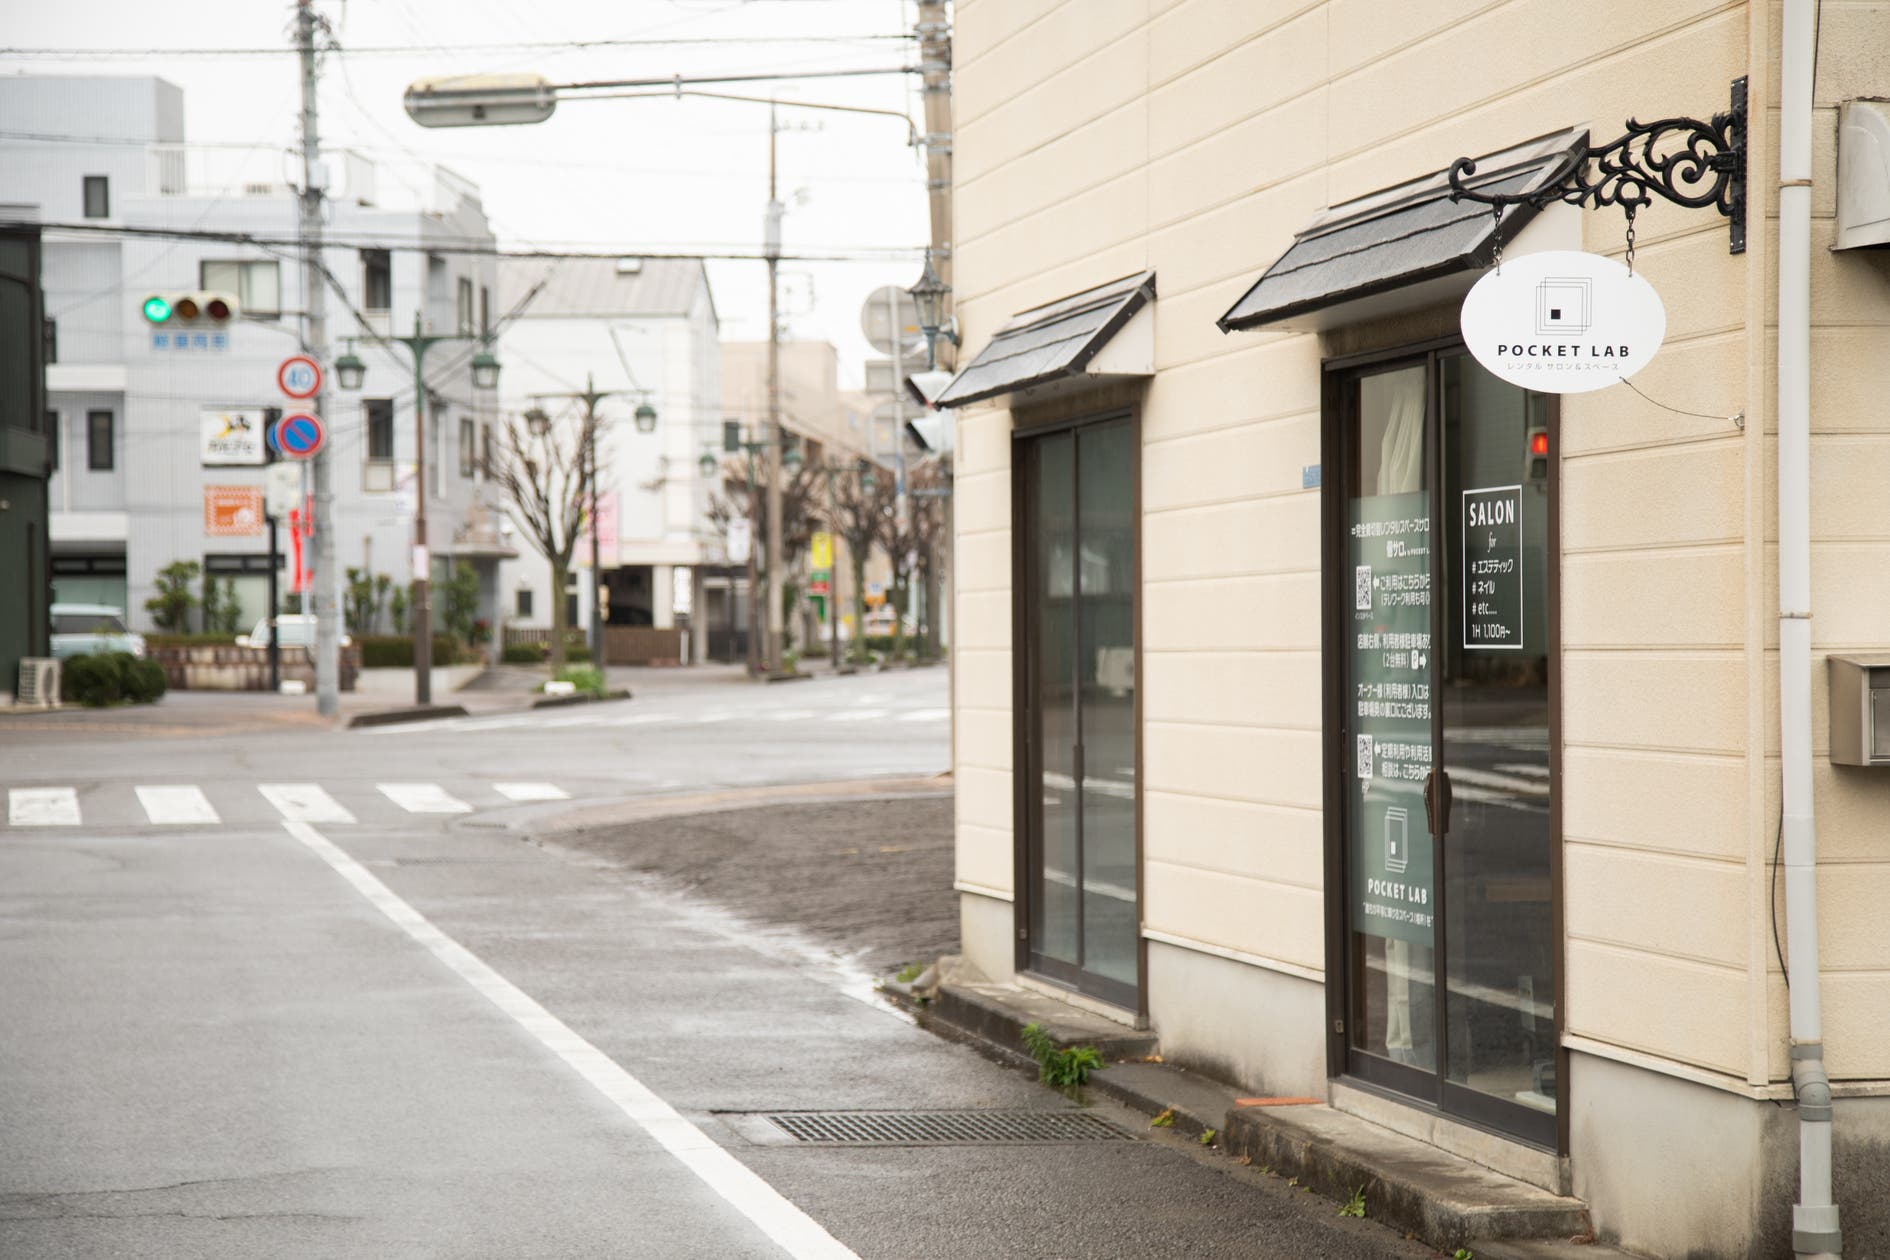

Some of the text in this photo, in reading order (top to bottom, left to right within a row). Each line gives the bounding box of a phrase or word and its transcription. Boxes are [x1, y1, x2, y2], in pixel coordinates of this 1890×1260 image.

[1498, 344, 1630, 357] POCKET LAB
[1507, 362, 1619, 371] レンタル サロン&スペース
[287, 368, 311, 388] 40
[1469, 498, 1515, 527] SALON
[1487, 531, 1497, 553] for
[1471, 558, 1514, 574] # エステティック
[1380, 575, 1430, 591] ご利用はこちらから
[1471, 580, 1495, 595] # ネイル
[1471, 602, 1477, 615] #
[1472, 624, 1480, 638] 1H
[1367, 877, 1428, 905] POCKET LAB
